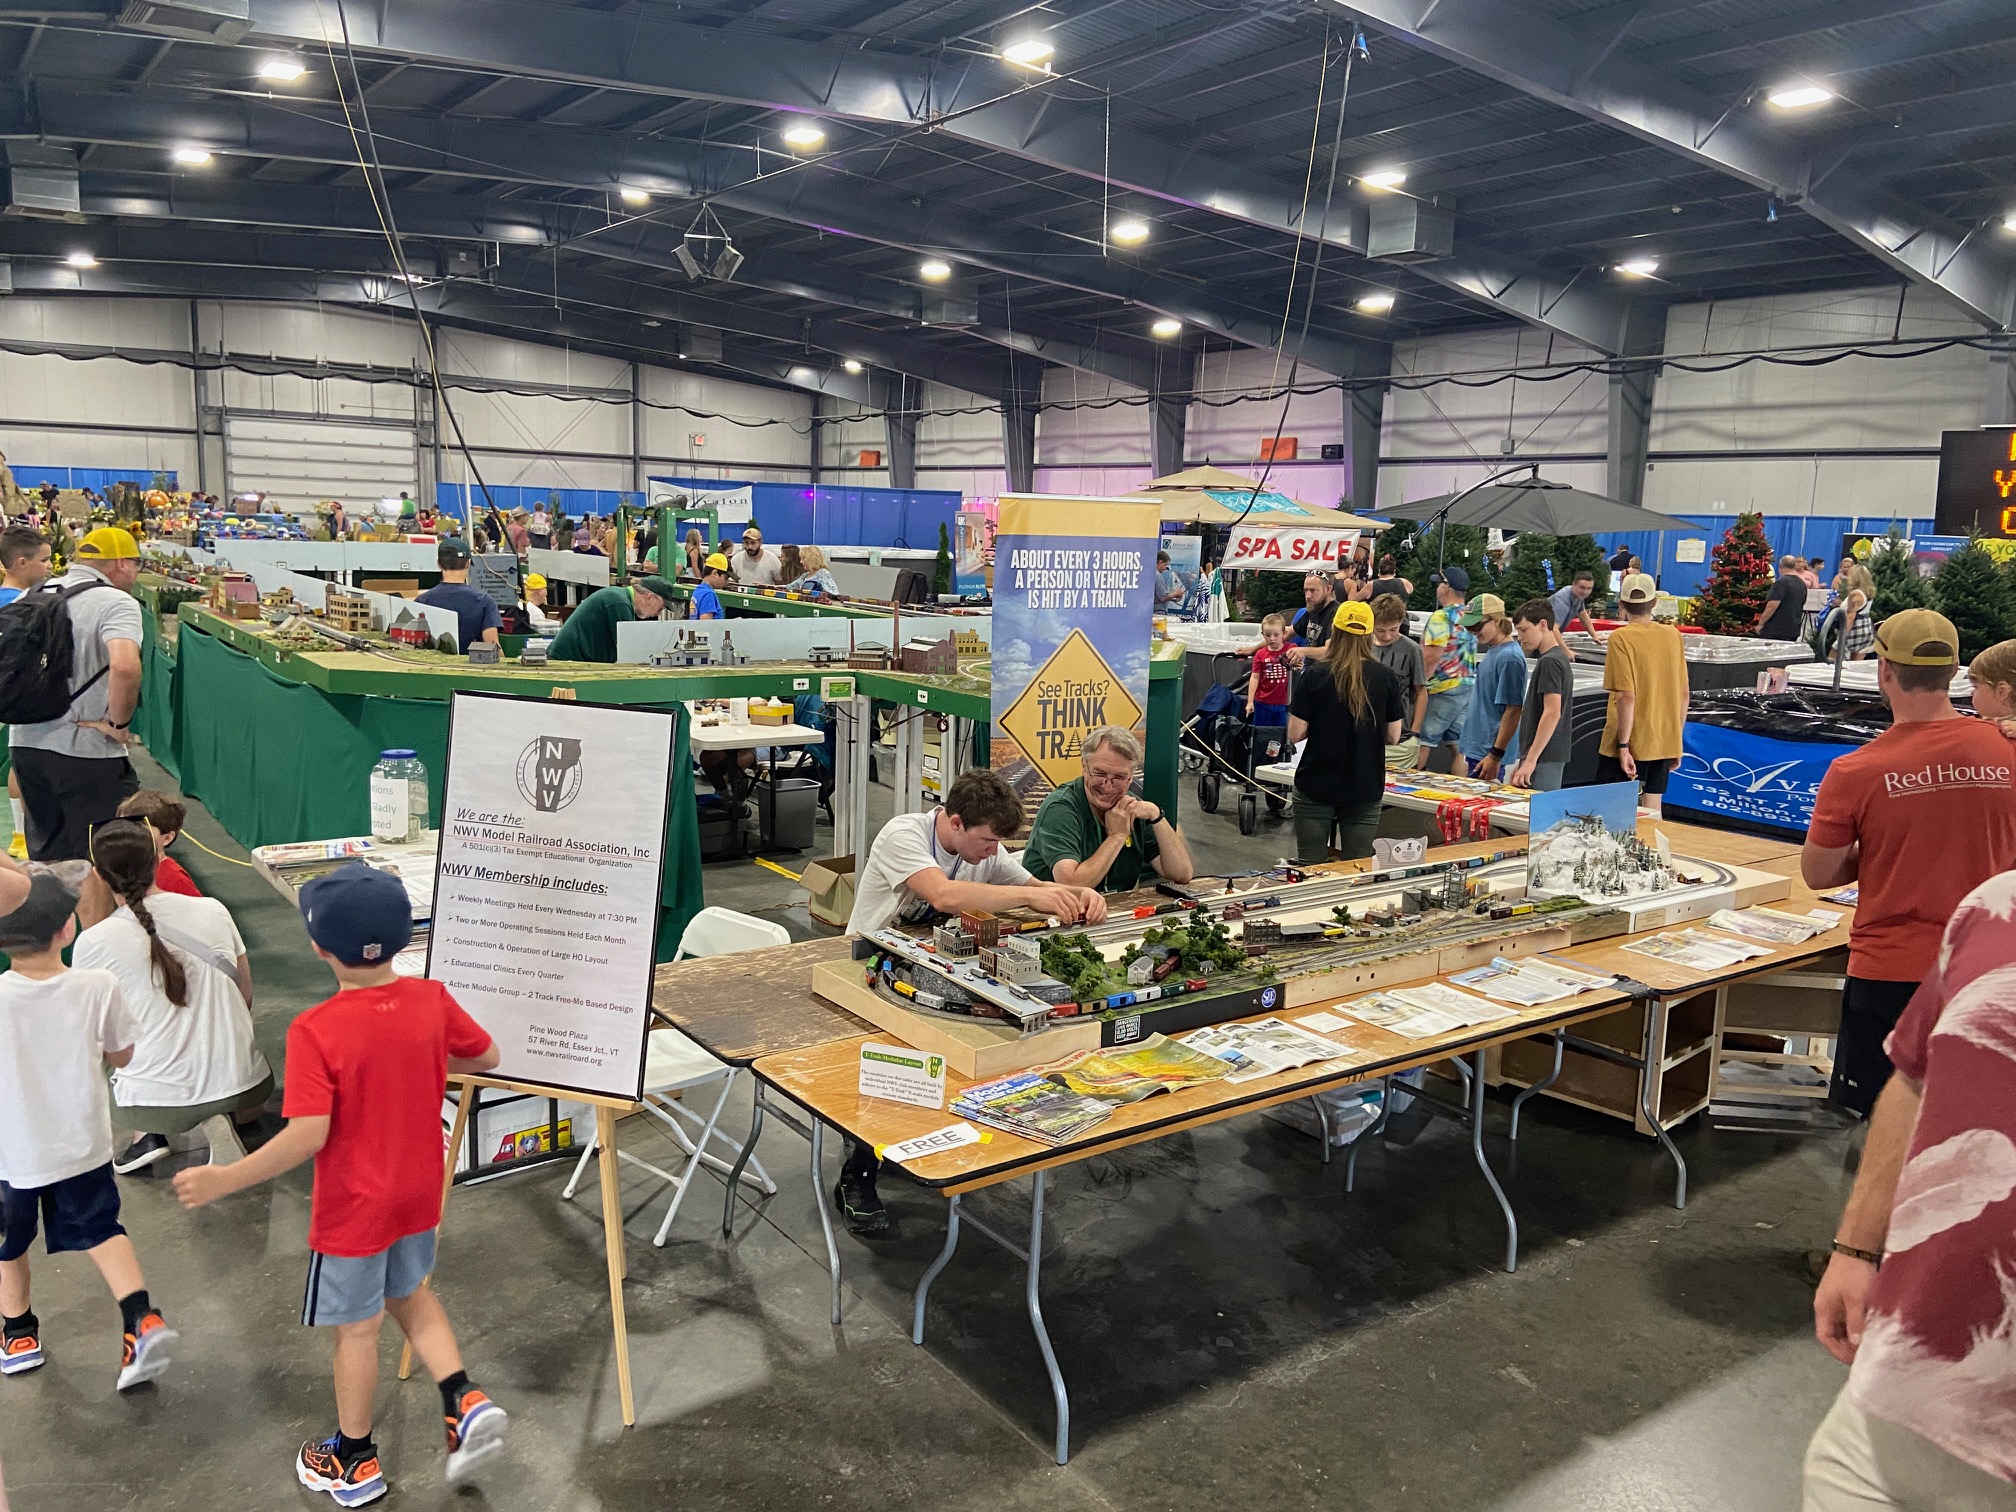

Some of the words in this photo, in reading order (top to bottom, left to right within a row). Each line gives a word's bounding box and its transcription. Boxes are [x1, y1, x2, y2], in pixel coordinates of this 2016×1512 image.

[1010, 550, 1053, 570] ABOUT
[1054, 550, 1091, 570] EVERY
[1092, 551, 1100, 570] 3
[1102, 551, 1144, 572] HOURS,
[1234, 536, 1282, 560] SPA
[1290, 538, 1352, 562] SALE
[1014, 570, 1024, 589] A
[1026, 570, 1073, 589] PERSON
[1075, 570, 1090, 589] OR
[1092, 570, 1139, 589] VEHICLE
[1028, 590, 1040, 609] IS
[1041, 590, 1062, 609] HIT
[1064, 590, 1080, 608] BY
[1080, 590, 1089, 608] A
[1090, 590, 1127, 608] TRAIN.
[1038, 680, 1062, 698] See
[1064, 679, 1110, 698] Tracks?
[1037, 696, 1108, 730] THINK
[1036, 726, 1104, 760] TRA
[372, 784, 394, 795] tions
[1884, 766, 1932, 792] Red
[1937, 764, 2010, 783] House
[1692, 784, 1731, 796] 332
[1736, 794, 1768, 805] RT
[372, 820, 392, 830] pted
[457, 807, 476, 820] We
[478, 812, 499, 824] are
[502, 812, 526, 826] the:
[453, 825, 480, 838] NWV
[482, 828, 515, 842] Model
[518, 832, 563, 848] Railroad
[566, 838, 630, 857] Association,
[634, 846, 650, 858] Inc
[468, 843, 502, 854] 501(c)(3)
[503, 846, 515, 855] Tax
[516, 848, 542, 858] Exempt
[544, 850, 585, 863] Educational
[588, 856, 633, 869] Organization
[441, 862, 472, 876] NWV
[474, 868, 550, 888] Membership
[553, 876, 608, 894] includes:
[458, 894, 483, 906] Weekly
[484, 897, 516, 910] Meetings
[518, 900, 534, 911] Held
[535, 904, 554, 914] Every
[556, 906, 596, 920] Wednesday
[608, 912, 624, 923] 7:30
[626, 915, 638, 924] PM
[456, 916, 470, 924] Two
[480, 918, 498, 928] More
[499, 920, 534, 934] Operating
[534, 926, 566, 938] Sessions
[567, 929, 584, 940] Held
[585, 932, 602, 942] Each
[604, 934, 627, 946] Month
[453, 937, 497, 950] Construction
[498, 942, 505, 950] &
[506, 944, 541, 956] Operation
[542, 948, 550, 956] of
[550, 950, 571, 961] Large
[572, 952, 584, 961] HO
[584, 954, 608, 966] Layout
[450, 958, 492, 971] Educational
[493, 964, 516, 974] Clinics
[518, 967, 536, 978] Every
[538, 970, 564, 982] Quarter
[448, 980, 470, 990] Active
[472, 984, 498, 994] Module
[498, 987, 520, 998] Group
[528, 991, 534, 999] 2
[535, 992, 554, 1002] Track
[556, 994, 584, 1006] Free-Mo
[586, 998, 608, 1010] Based
[609, 1001, 634, 1014] Design
[530, 1024, 546, 1034] Pine
[547, 1027, 568, 1037] Wood
[568, 1030, 588, 1040] Plaza
[528, 1036, 538, 1044] 57
[540, 1038, 558, 1046] River
[559, 1040, 571, 1050] Rd,
[572, 1042, 592, 1052] Essex
[610, 1048, 620, 1056] VT
[966, 1082, 1014, 1098] Model
[900, 1130, 964, 1156] FREE
